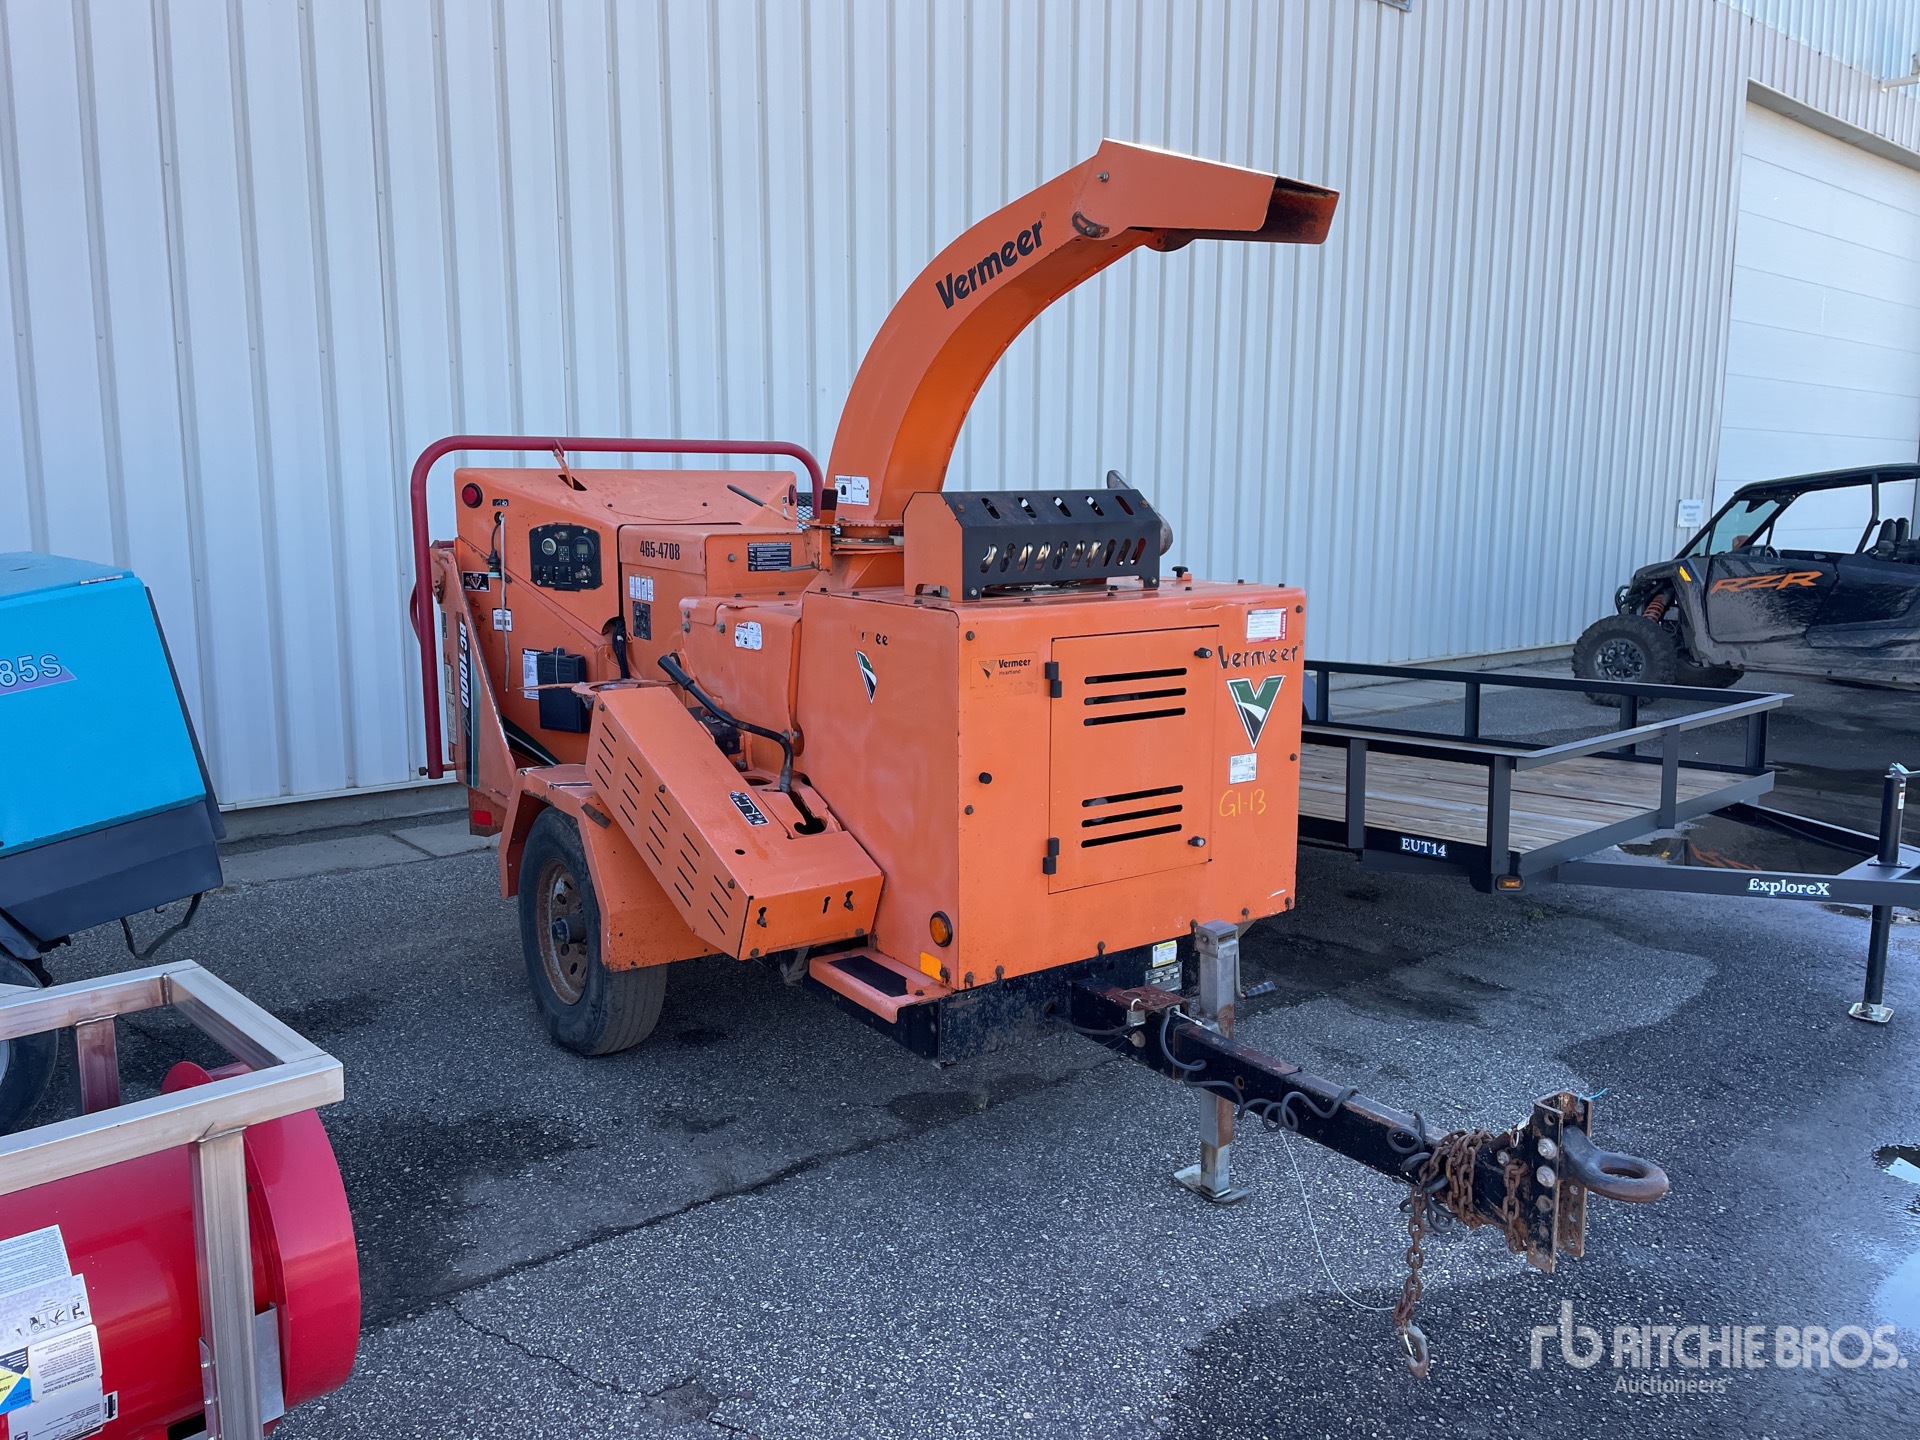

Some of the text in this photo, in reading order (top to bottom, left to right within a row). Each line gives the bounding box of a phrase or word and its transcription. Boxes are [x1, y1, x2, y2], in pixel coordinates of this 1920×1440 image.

[935, 220, 1043, 310] Vermeer
[640, 540, 680, 560] 465-4708
[1710, 571, 1823, 595] RZR
[999, 659, 1031, 669] Vermeer
[1217, 645, 1298, 669] Vermeer
[0, 653, 62, 687] 85S
[1401, 837, 1447, 857] EUT14
[1748, 878, 1830, 896] ExploreX
